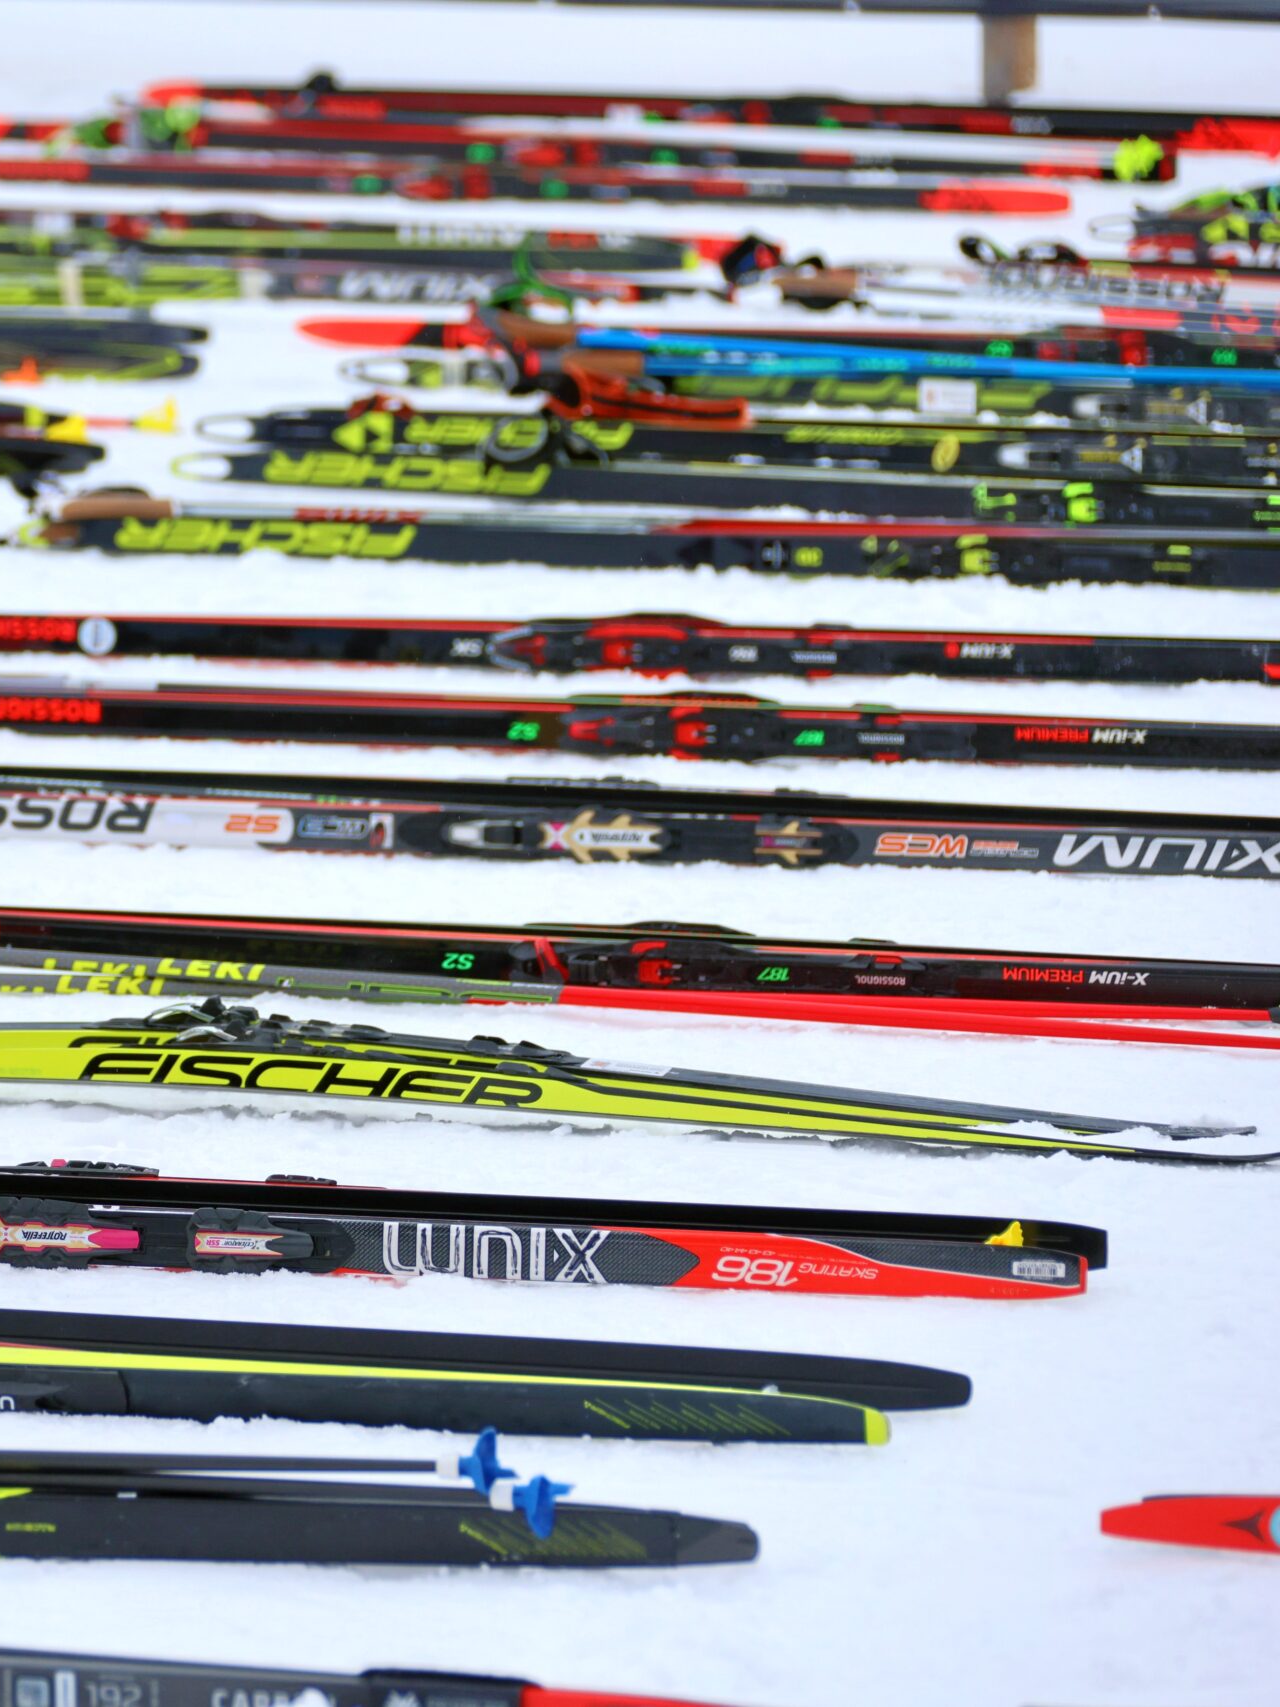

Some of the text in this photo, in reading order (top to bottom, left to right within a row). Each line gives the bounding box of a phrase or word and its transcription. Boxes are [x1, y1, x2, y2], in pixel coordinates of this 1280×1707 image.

[115, 515, 417, 558] FISCHER
[1014, 726, 1090, 744] PREMIUM
[874, 831, 969, 859] WCS
[156, 956, 267, 984] LEKI
[1002, 966, 1086, 984] PREMIUM
[78, 1051, 545, 1108] FISCHER
[711, 1255, 799, 1288] 186
[797, 1262, 879, 1281] SKATING
